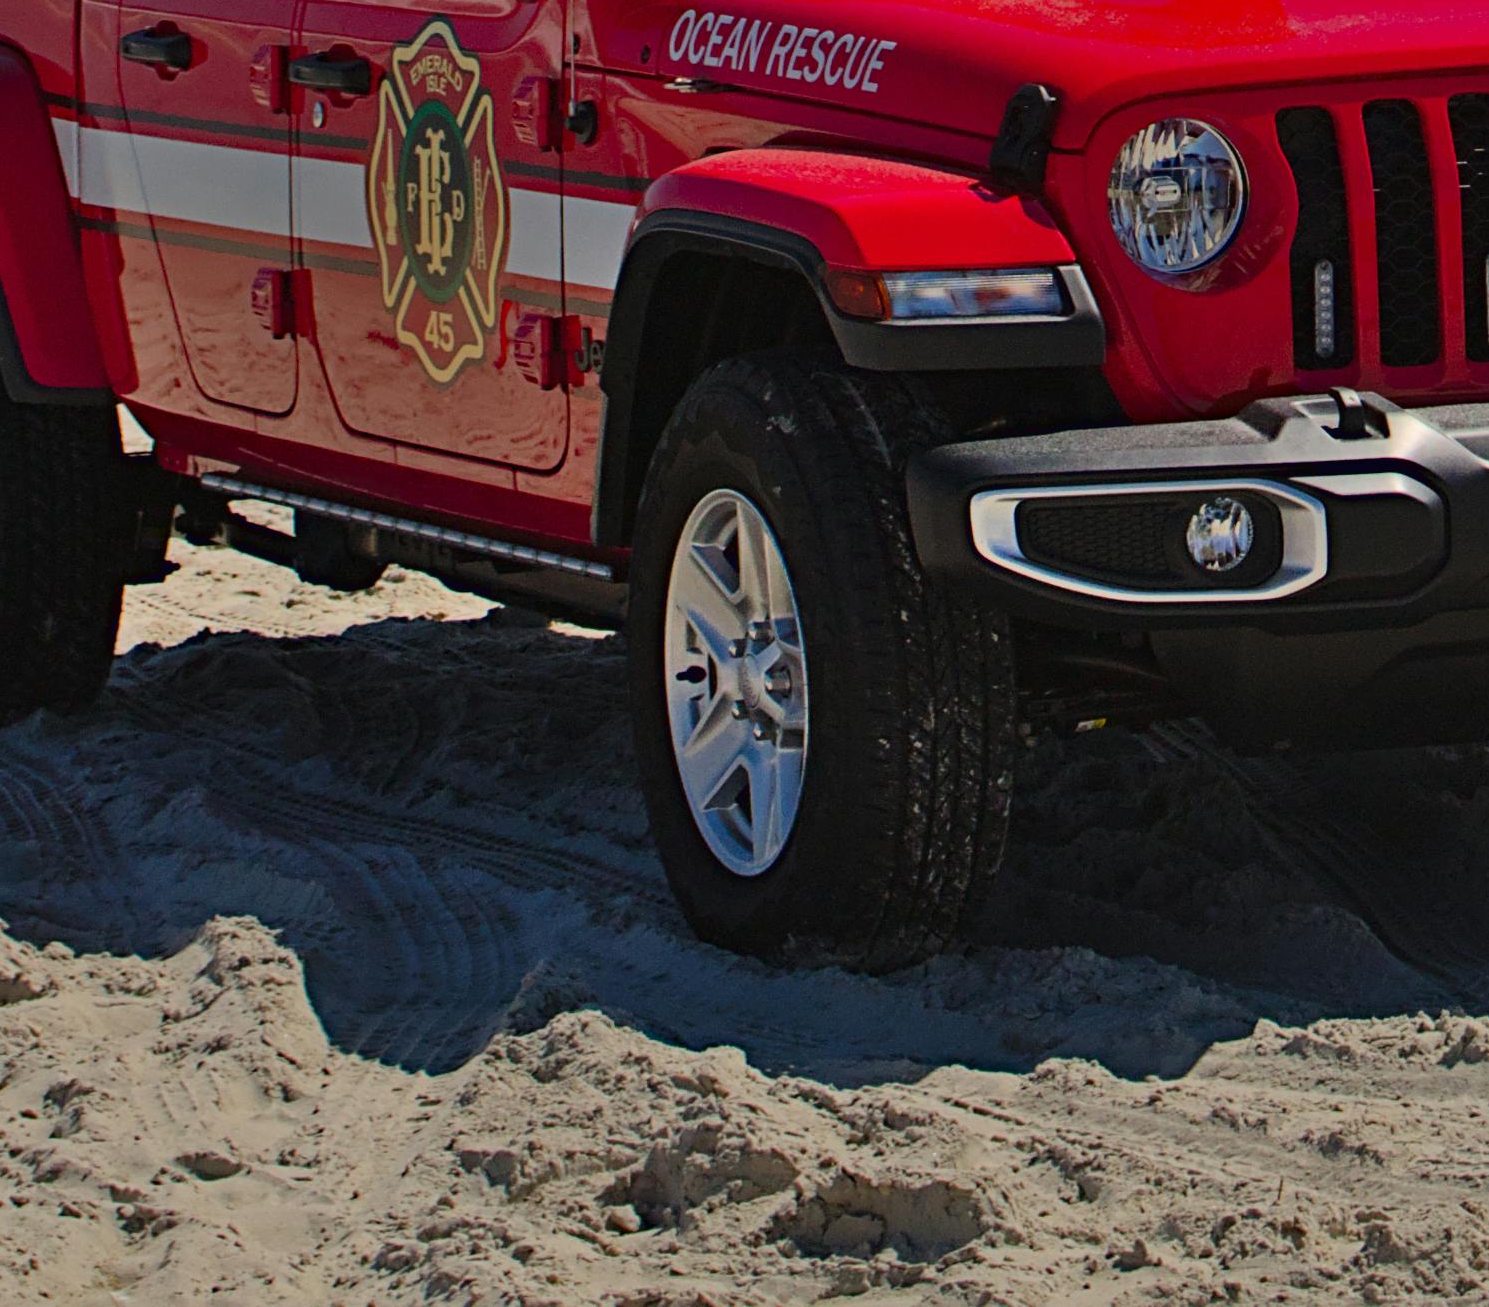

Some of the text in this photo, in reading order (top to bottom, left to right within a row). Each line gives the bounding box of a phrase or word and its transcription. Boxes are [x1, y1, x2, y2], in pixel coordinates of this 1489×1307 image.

[669, 9, 897, 92] OCEAN RESCUE
[409, 54, 462, 92] EMERALD
[426, 75, 447, 95] ISLE
[425, 310, 454, 352] 45
